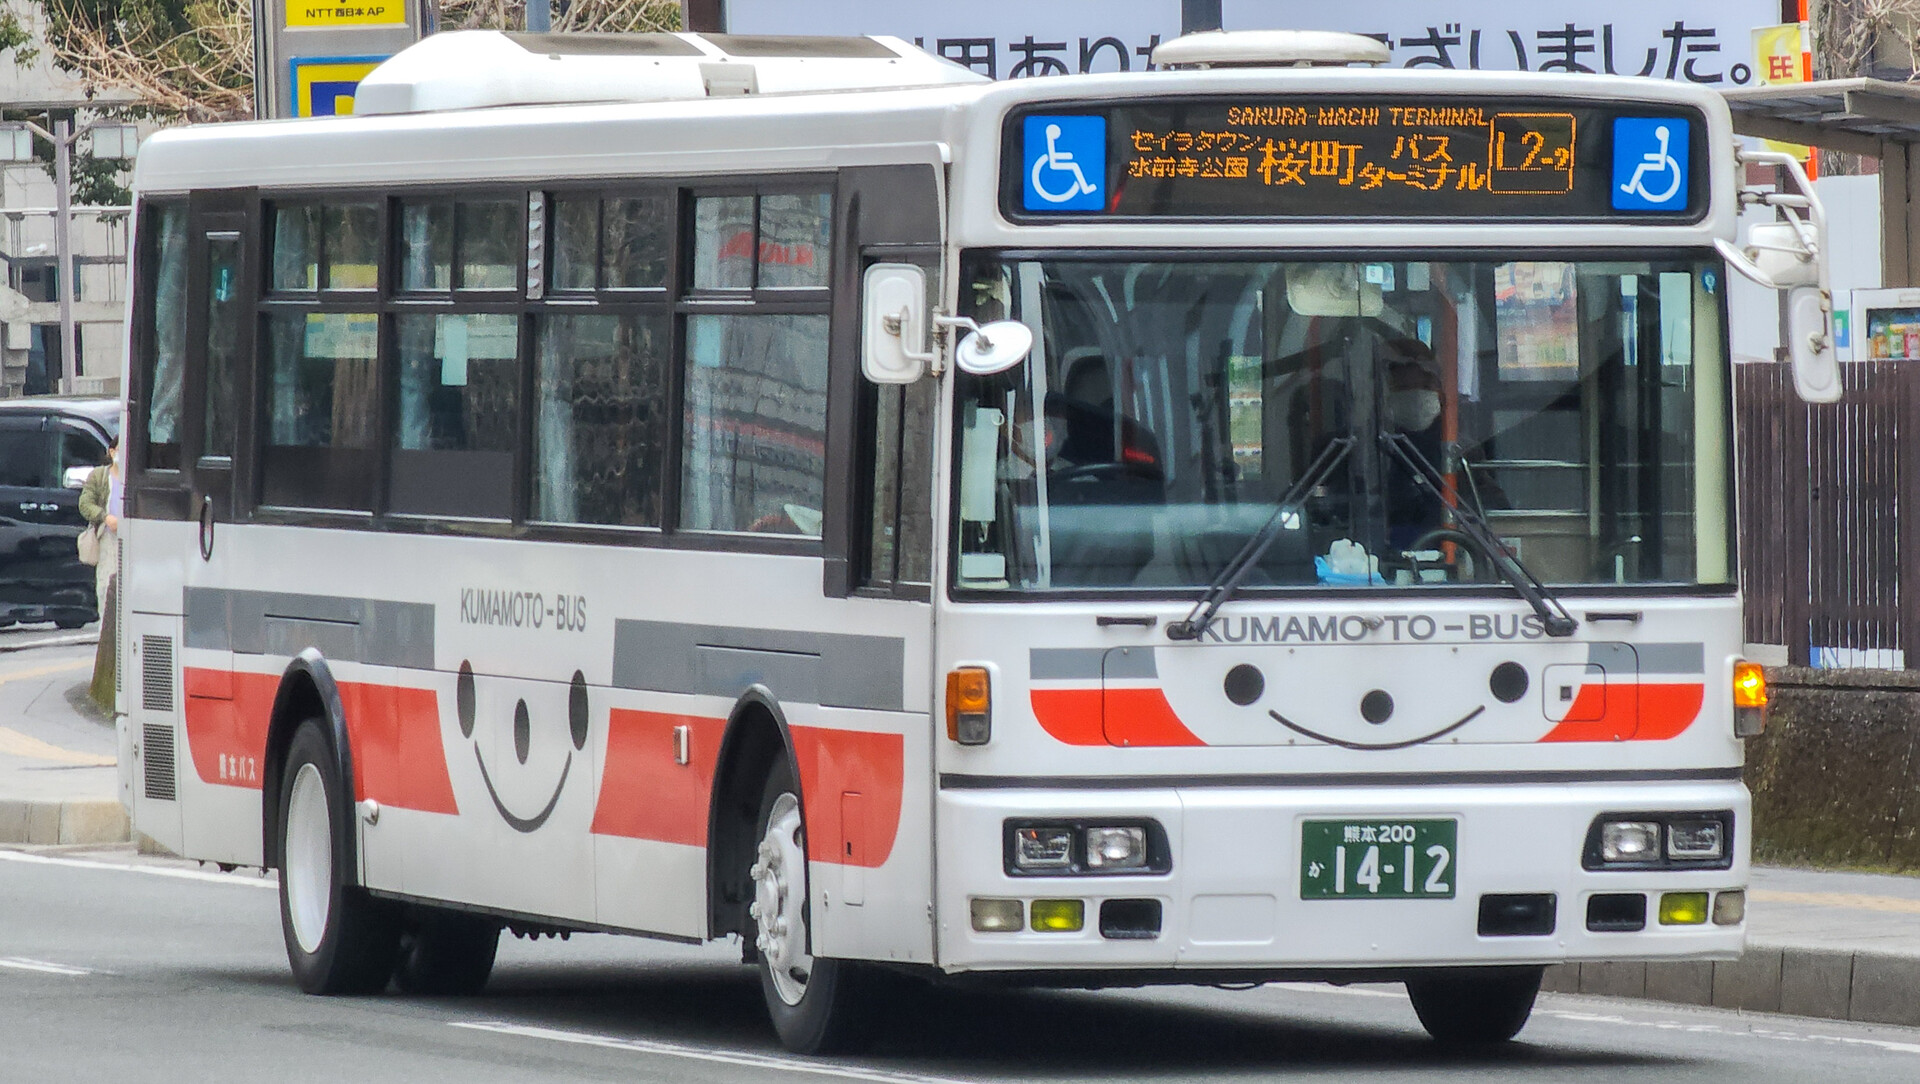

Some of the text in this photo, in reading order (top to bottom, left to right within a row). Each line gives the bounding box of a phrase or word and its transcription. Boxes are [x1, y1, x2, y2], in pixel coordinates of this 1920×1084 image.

[306, 7, 385, 18] NTT 西日本 AP
[1362, 21, 1751, 85] ざいました。
[1227, 106, 1489, 126] SAKURA-MACHI TERMINAL
[1130, 129, 1261, 152] セイラタウン
[1390, 133, 1453, 162] バス
[1128, 156, 1249, 178] 水前寺公園
[1256, 137, 1363, 186] 桜町
[1357, 162, 1487, 190] ターミナル
[460, 587, 587, 632] KUMAMOTO-BUS
[219, 753, 256, 782] 熊本バス
[1308, 845, 1450, 893] か 14-12
